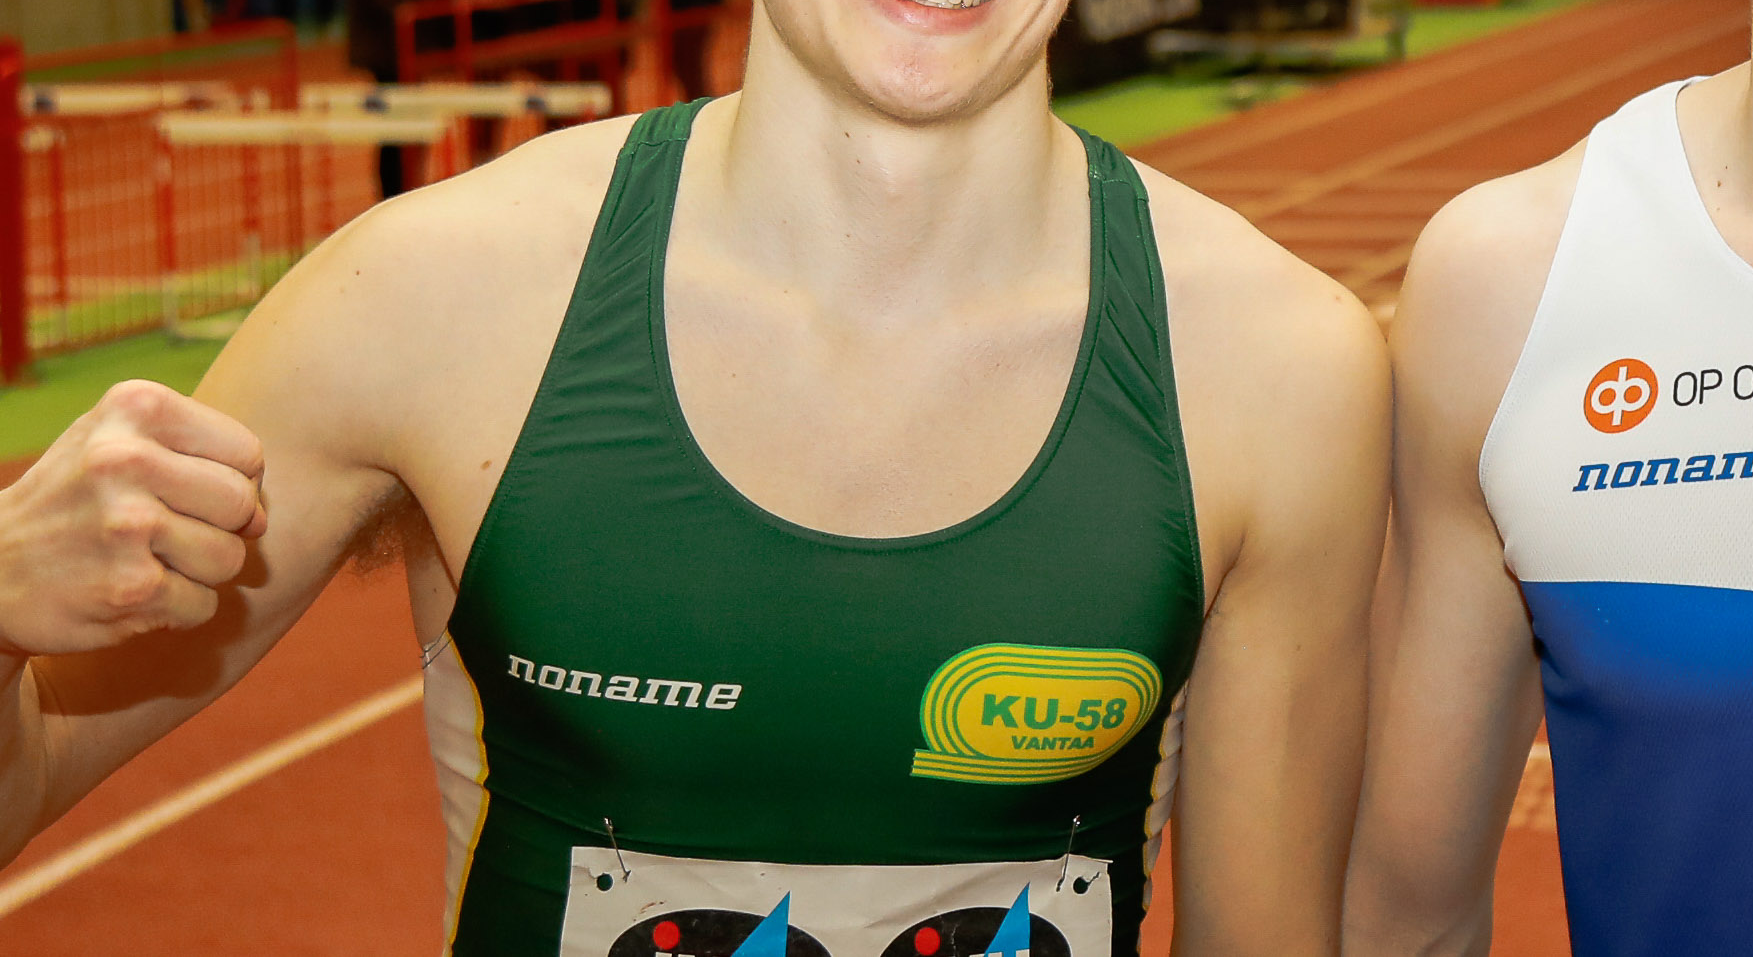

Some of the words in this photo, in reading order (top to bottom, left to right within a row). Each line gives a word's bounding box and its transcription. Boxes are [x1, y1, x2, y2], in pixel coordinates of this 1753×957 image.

[1672, 368, 1724, 407] OP
[507, 653, 743, 710] noname
[980, 693, 1128, 732] KU-58
[1011, 734, 1095, 751] VANTAA
